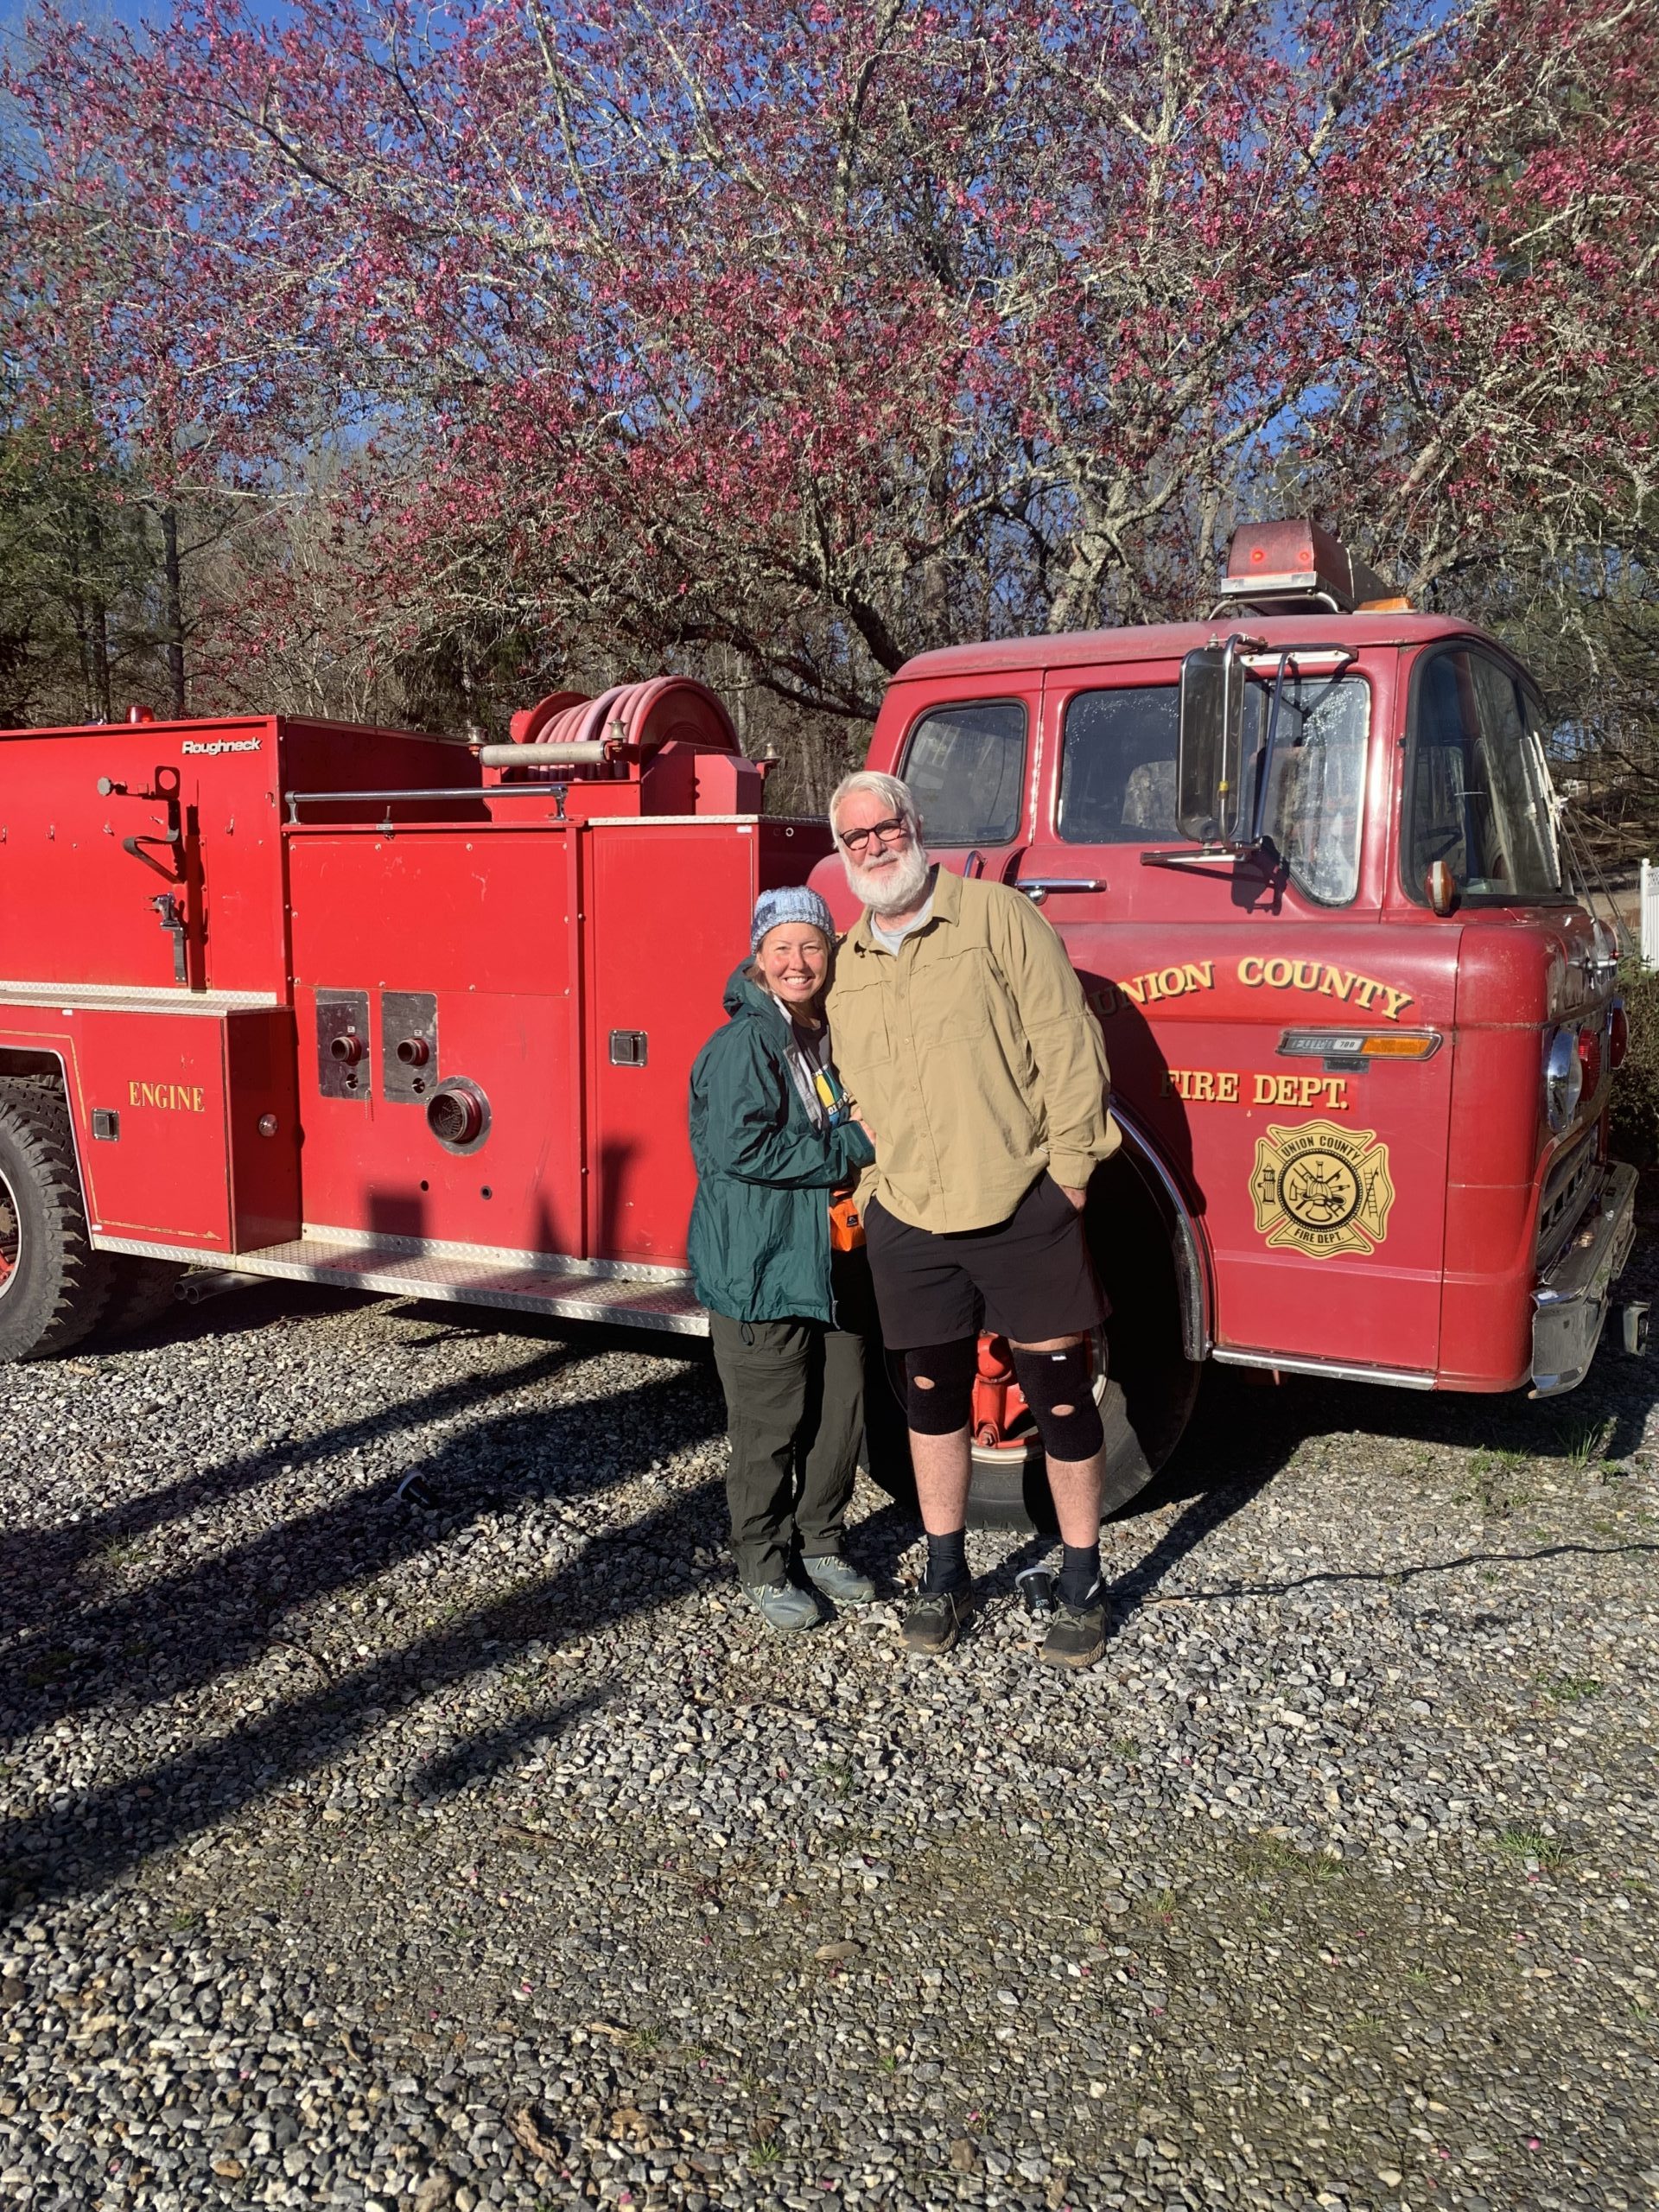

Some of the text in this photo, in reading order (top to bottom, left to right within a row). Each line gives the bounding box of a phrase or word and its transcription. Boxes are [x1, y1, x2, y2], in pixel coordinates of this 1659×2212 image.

[181, 736, 261, 756] Roughneck
[1090, 957, 1414, 1022] UNION COUNTY
[128, 1080, 205, 1113] ENGINE
[1159, 1069, 1349, 1109] FIRE DEPT.
[1281, 1135, 1361, 1161] UNION COUNTY
[1294, 1228, 1344, 1244] FIRE DEPT.
